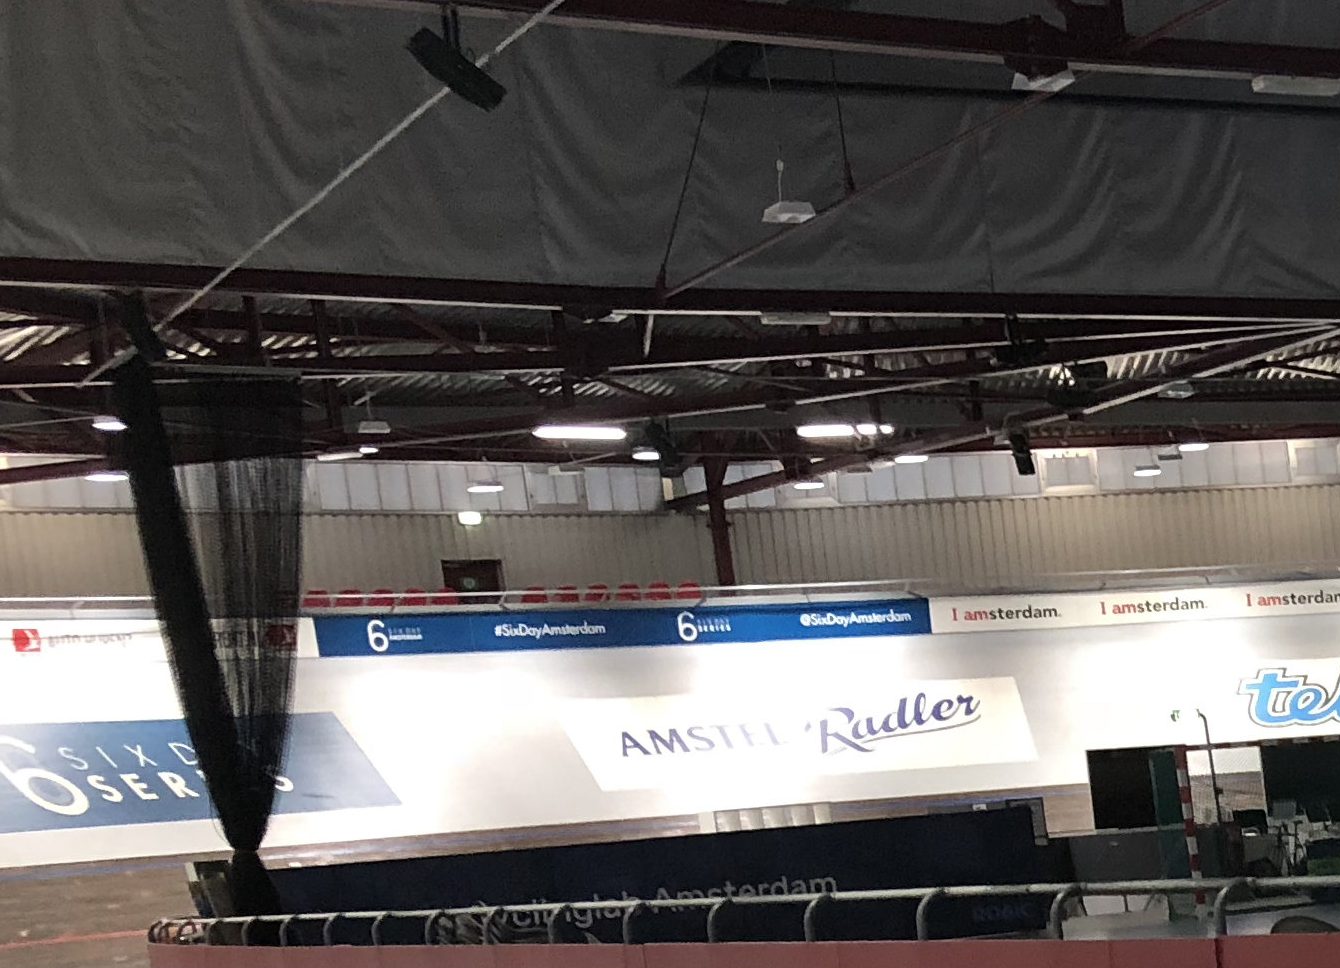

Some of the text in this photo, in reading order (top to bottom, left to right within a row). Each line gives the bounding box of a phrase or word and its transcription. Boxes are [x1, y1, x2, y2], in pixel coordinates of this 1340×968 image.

[1100, 601, 1107, 615] I
[1246, 593, 1253, 607] I
[677, 611, 698, 642] 6
[800, 609, 912, 627] @SixDayAmsterdam
[952, 608, 958, 622] I
[367, 619, 389, 652] 6
[494, 619, 606, 640] #SixDayAmsterdam
[621, 692, 982, 757] AMSTEL Radler
[58, 743, 158, 770] SIX
[87, 770, 295, 803] SERS
